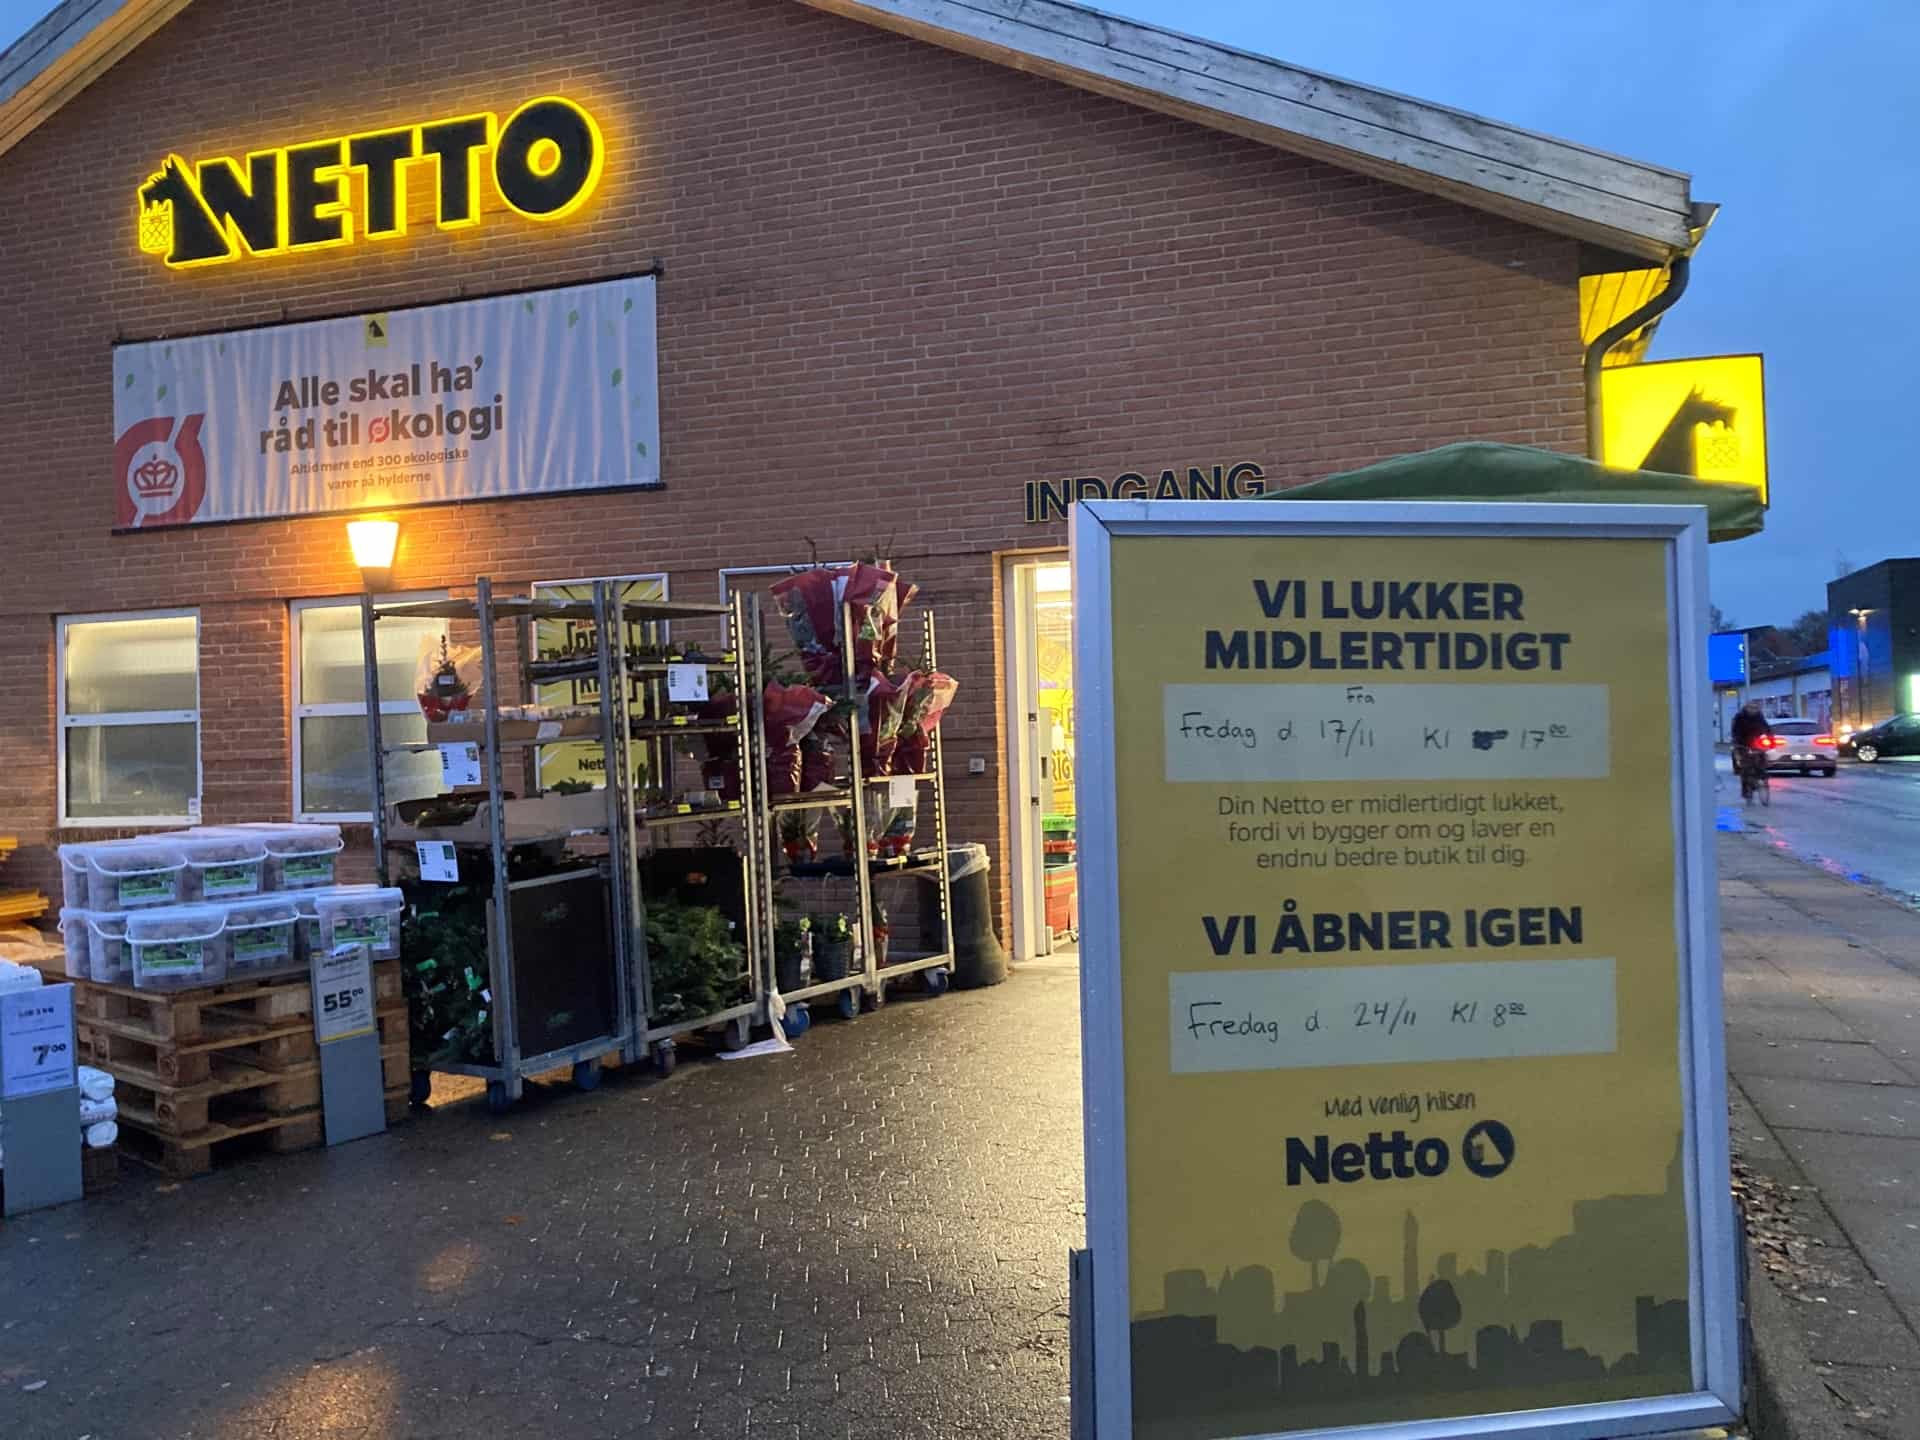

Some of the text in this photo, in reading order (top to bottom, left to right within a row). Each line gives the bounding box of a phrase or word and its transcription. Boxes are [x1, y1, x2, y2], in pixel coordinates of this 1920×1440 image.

[196, 95, 605, 257] NETTO
[274, 354, 484, 411] Alle skal ha'
[260, 393, 503, 454] råd til økologi
[353, 454, 374, 469] end
[377, 454, 402, 467] 300
[1253, 579, 1525, 622] VI LUKKER
[1204, 630, 1571, 671] MIDLERTIDIGT
[1346, 686, 1375, 705] Fra
[1181, 712, 1257, 749] Fredag
[1320, 718, 1375, 758] 17/11
[1218, 792, 1565, 816] Din Netto er midlertidigt lukket,
[1228, 819, 1556, 844] fordi vi bygger om og laver en
[1256, 849, 1328, 869] endnu
[1334, 848, 1399, 868] bedre
[1404, 845, 1461, 866] butik
[1465, 844, 1487, 865] til
[1202, 899, 1583, 955] VI ÅBNER IGEN
[1187, 1001, 1279, 1042] Fredag
[1355, 999, 1417, 1035] 24/11
[1324, 1091, 1477, 1123] Med venlig hilsen
[1285, 1130, 1451, 1187] Netto
